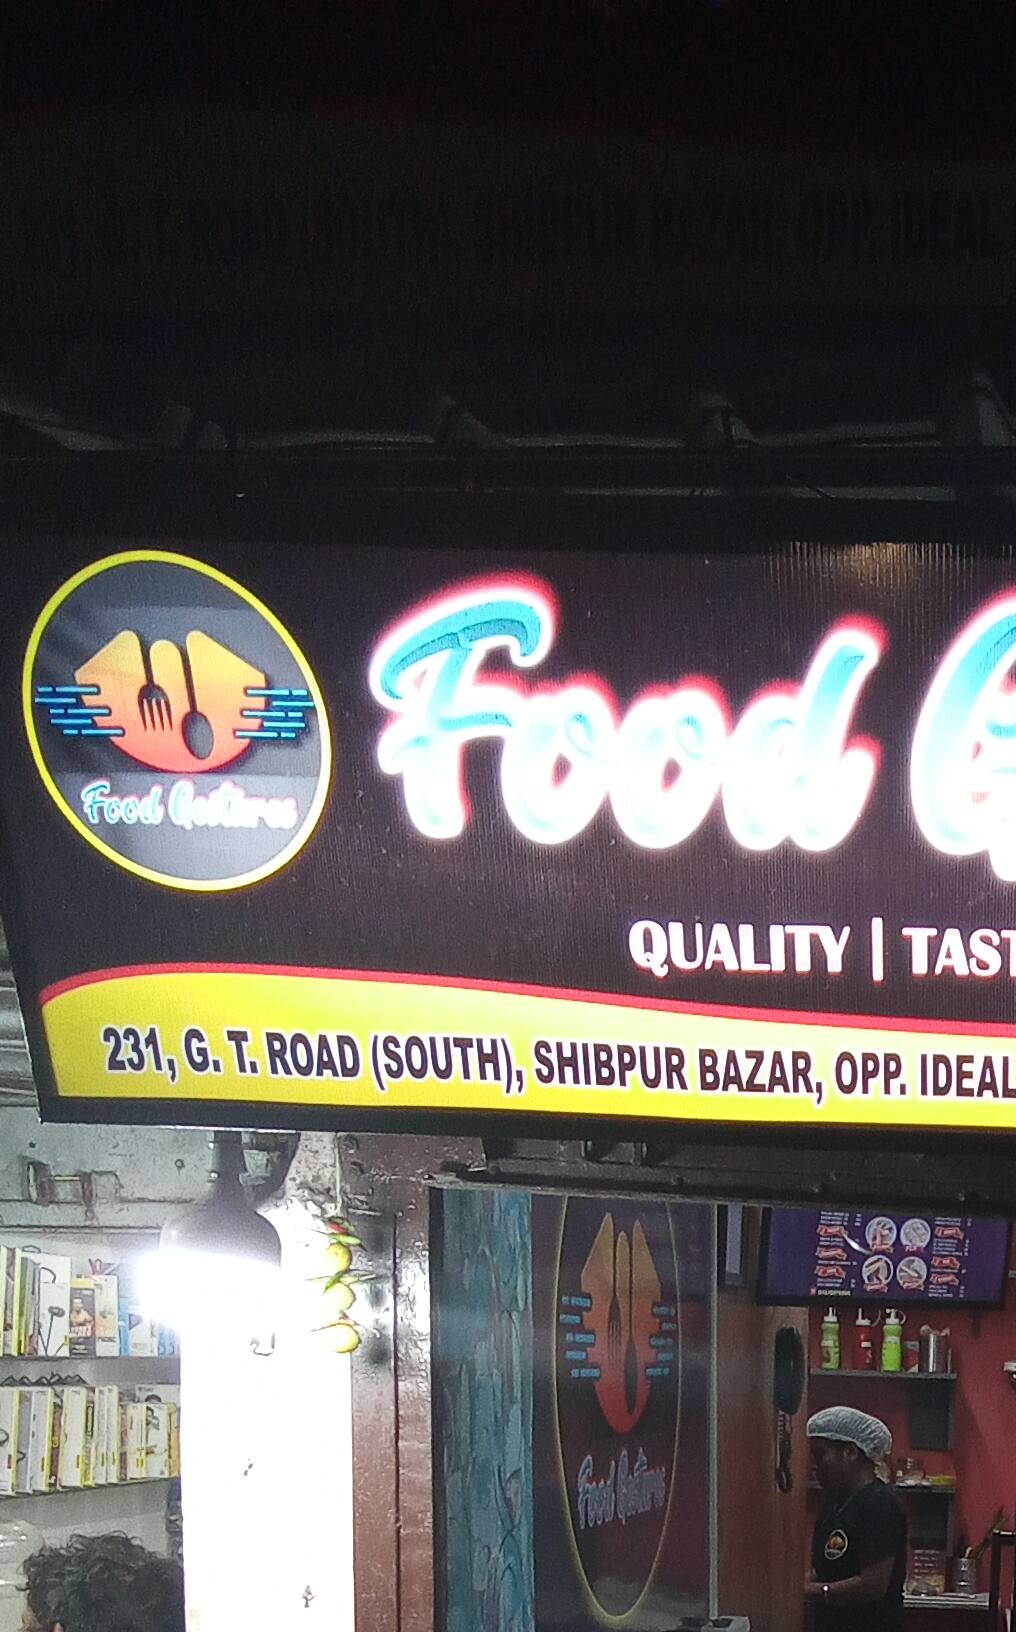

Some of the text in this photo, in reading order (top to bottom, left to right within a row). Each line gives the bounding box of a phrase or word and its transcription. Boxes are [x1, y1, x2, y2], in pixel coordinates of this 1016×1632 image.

[368, 586, 886, 852] Food
[80, 778, 164, 825] Food
[628, 919, 853, 979] QUALITY
[102, 1026, 177, 1083] 231,
[184, 1028, 222, 1073] G.
[226, 1030, 259, 1074] T.
[265, 1031, 360, 1079] ROAD
[371, 1035, 524, 1094] (SOUTH),
[534, 1040, 689, 1090] SHIBPUR
[698, 1047, 823, 1105] BAZAR,
[835, 1051, 907, 1096] OPP.
